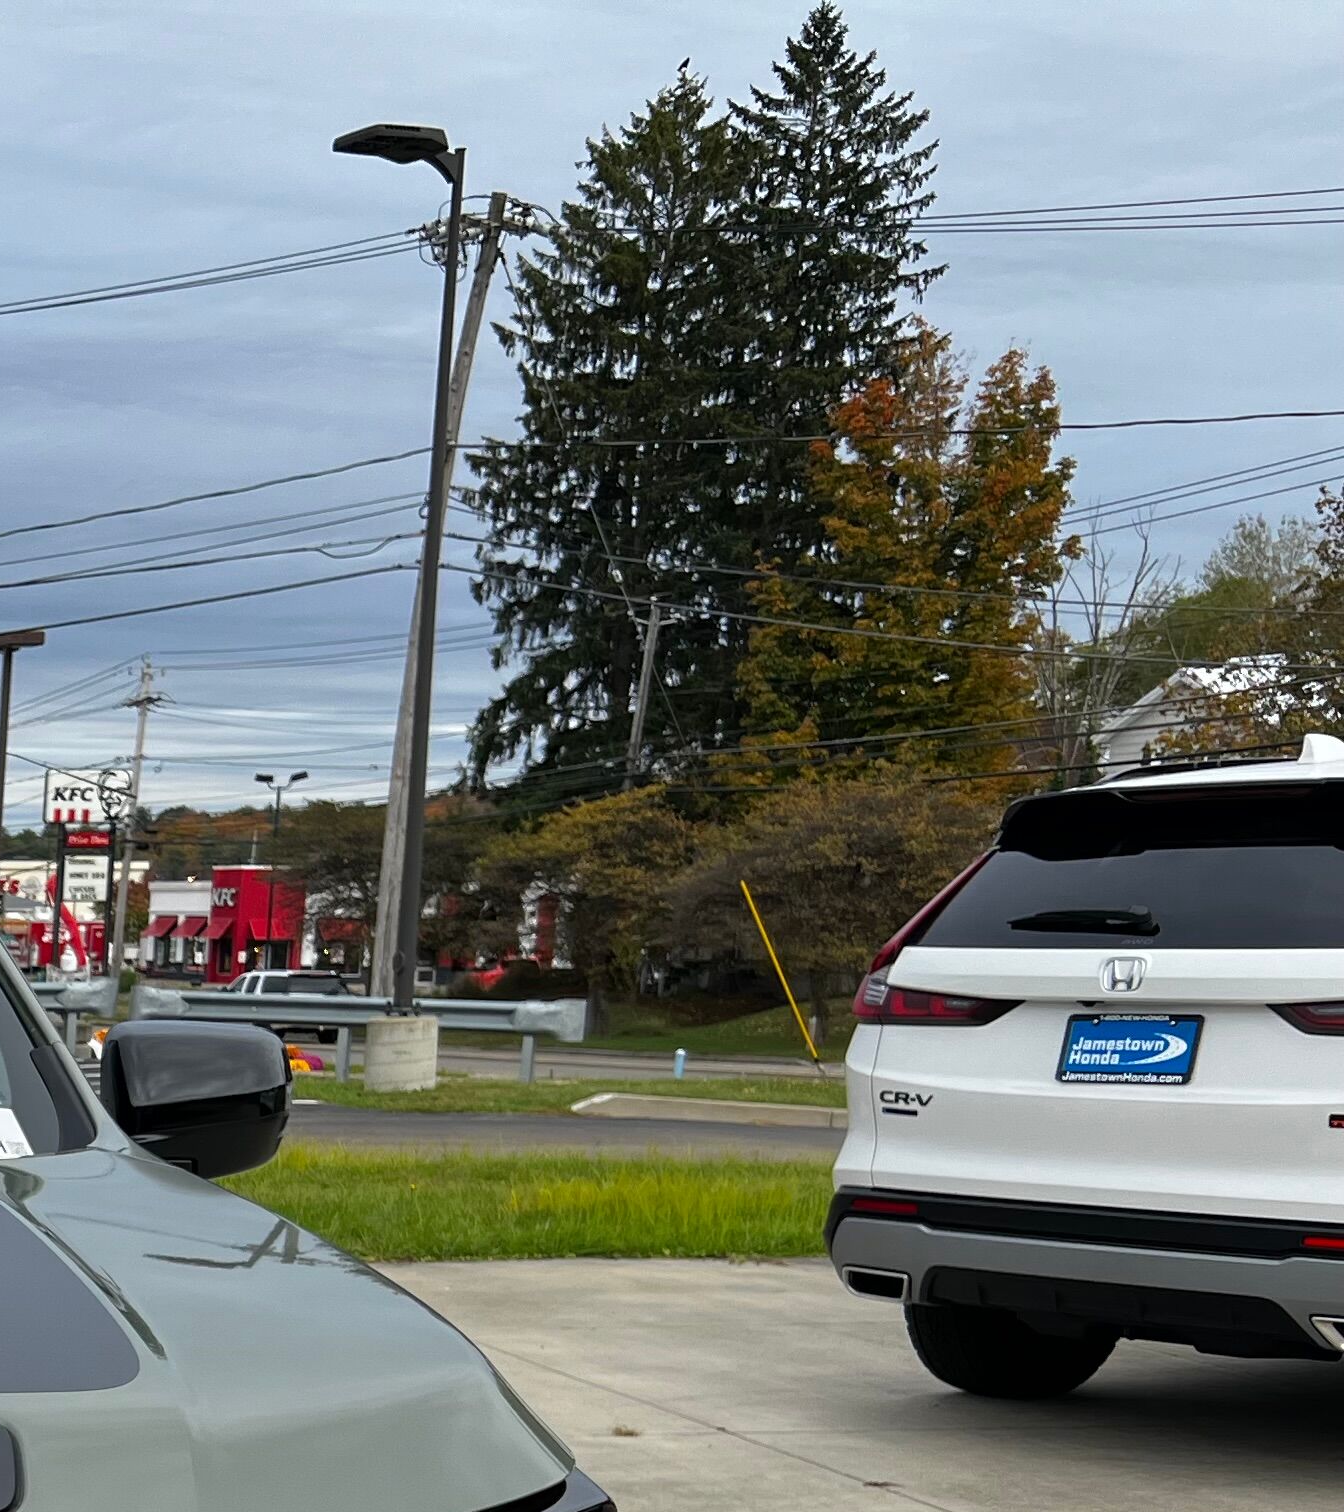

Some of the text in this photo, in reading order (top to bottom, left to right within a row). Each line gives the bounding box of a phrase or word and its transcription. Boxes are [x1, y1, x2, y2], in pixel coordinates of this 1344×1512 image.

[52, 787, 94, 801] KFC
[212, 888, 236, 907] KFC
[1072, 1037, 1165, 1051] Jamestown
[1068, 1050, 1120, 1065] Honda
[1061, 1071, 1183, 1083] JamestownHonda.com
[879, 1090, 933, 1107] CR-V
